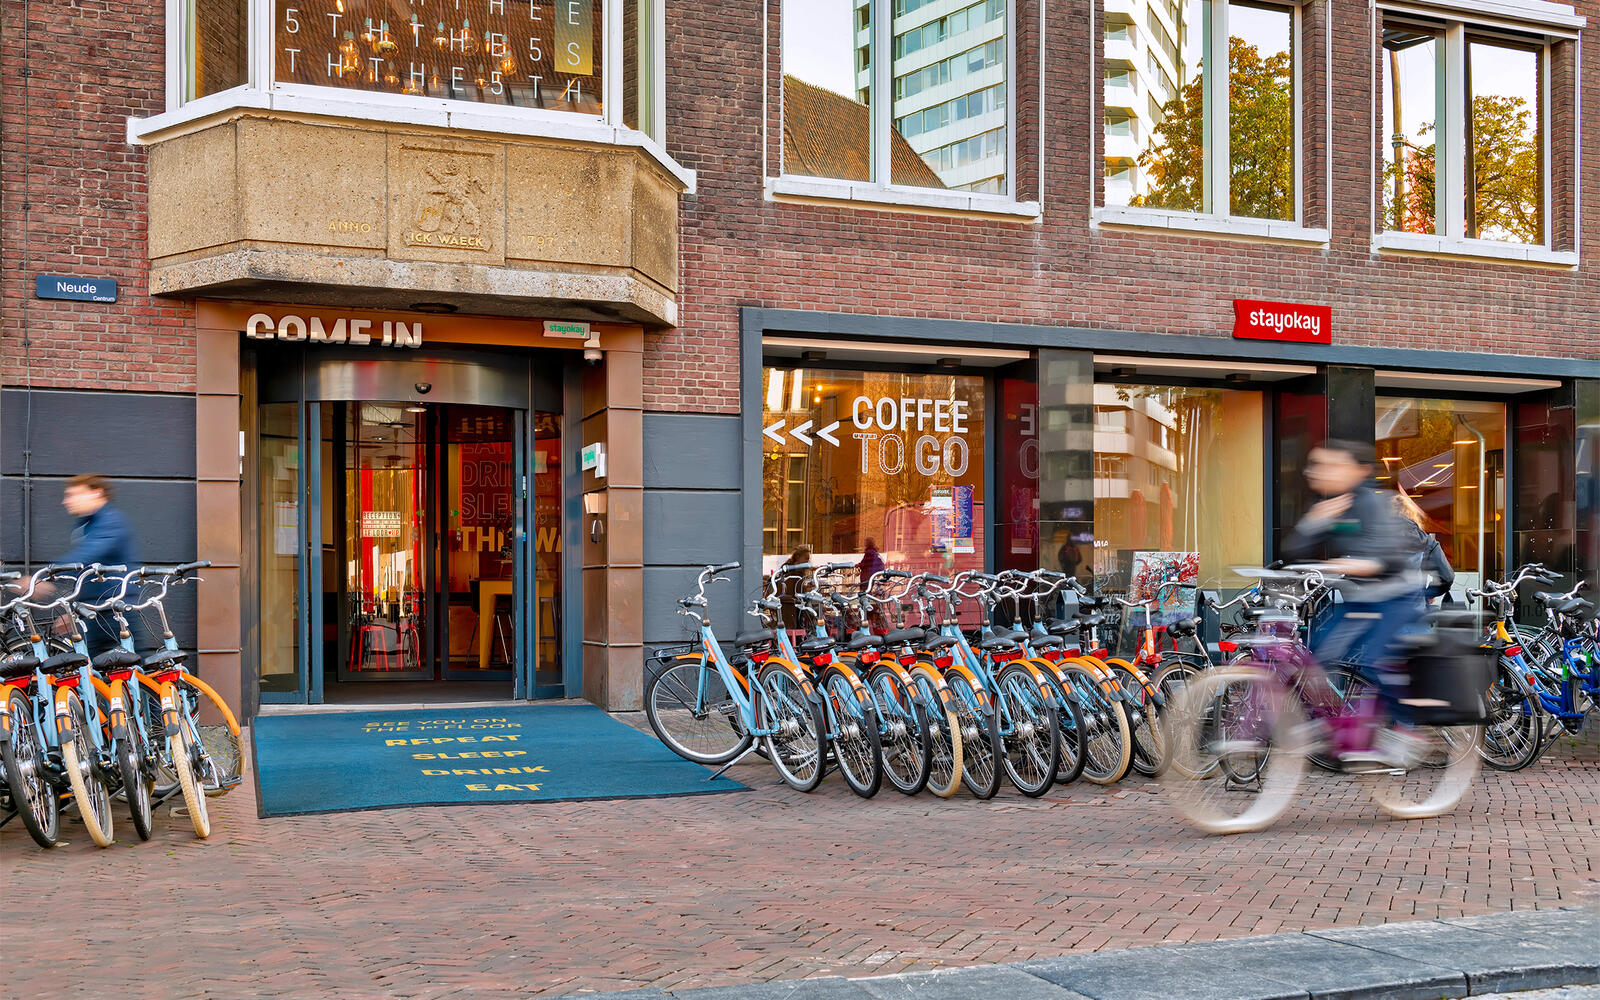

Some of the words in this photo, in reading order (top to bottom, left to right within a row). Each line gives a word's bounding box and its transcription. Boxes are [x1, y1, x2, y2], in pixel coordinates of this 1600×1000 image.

[327, 219, 372, 234] ANNO
[410, 232, 432, 244] ICK
[437, 234, 484, 248] WAECK
[56, 281, 97, 294] Neude
[1249, 308, 1320, 336] stayokay
[246, 313, 371, 345] COME
[380, 320, 423, 349] IN
[549, 324, 585, 336] stayokay
[852, 395, 969, 434] COFFEE
[852, 433, 904, 475] TO
[914, 434, 969, 477] GO
[444, 723, 523, 731] FLOOR
[385, 735, 521, 747] REPEAT
[411, 750, 528, 760] SLEEP
[421, 765, 550, 776] DRINK
[464, 783, 544, 792] EAT
